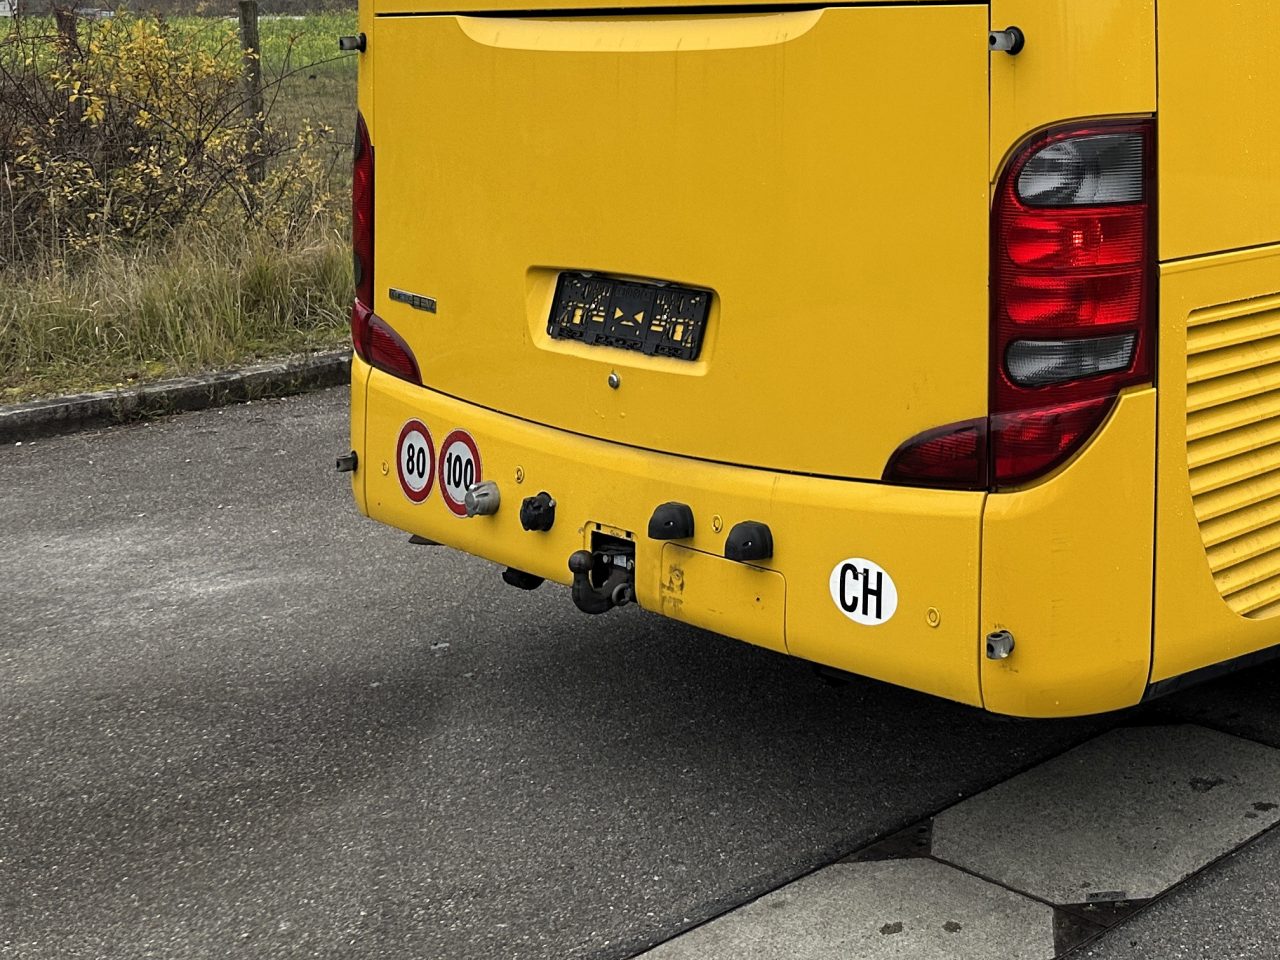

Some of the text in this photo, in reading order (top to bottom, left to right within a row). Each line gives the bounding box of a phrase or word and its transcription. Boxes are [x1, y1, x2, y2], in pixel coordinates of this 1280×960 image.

[406, 443, 426, 479] 80
[447, 452, 474, 492] 100
[840, 563, 883, 620] CH
